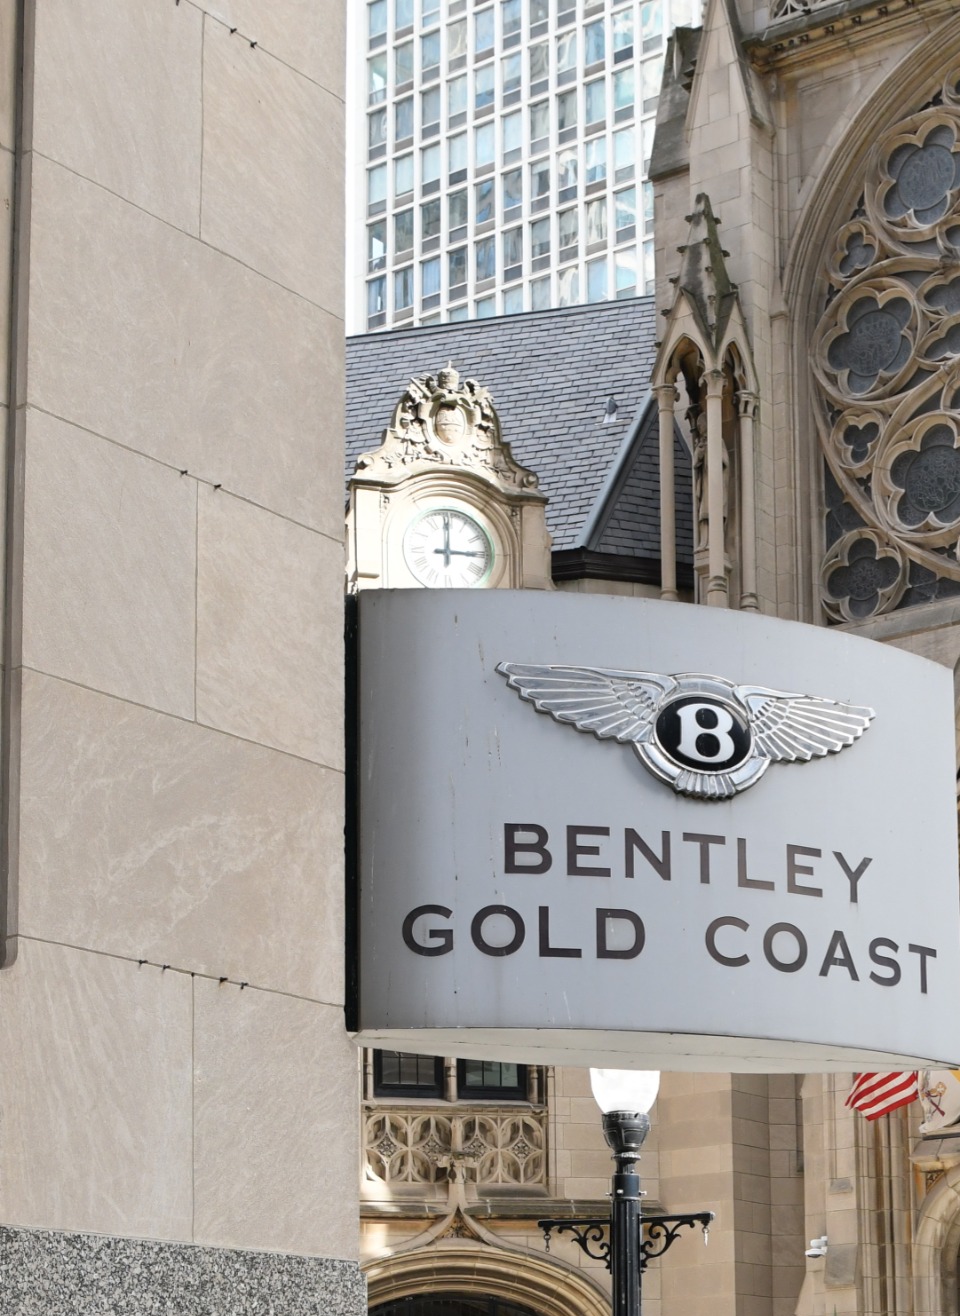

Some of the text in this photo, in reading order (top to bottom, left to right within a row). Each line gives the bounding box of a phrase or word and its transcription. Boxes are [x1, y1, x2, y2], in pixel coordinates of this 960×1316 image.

[676, 702, 736, 764] B
[504, 822, 873, 903] BENTLEY
[401, 904, 938, 994] GOLD COAST
